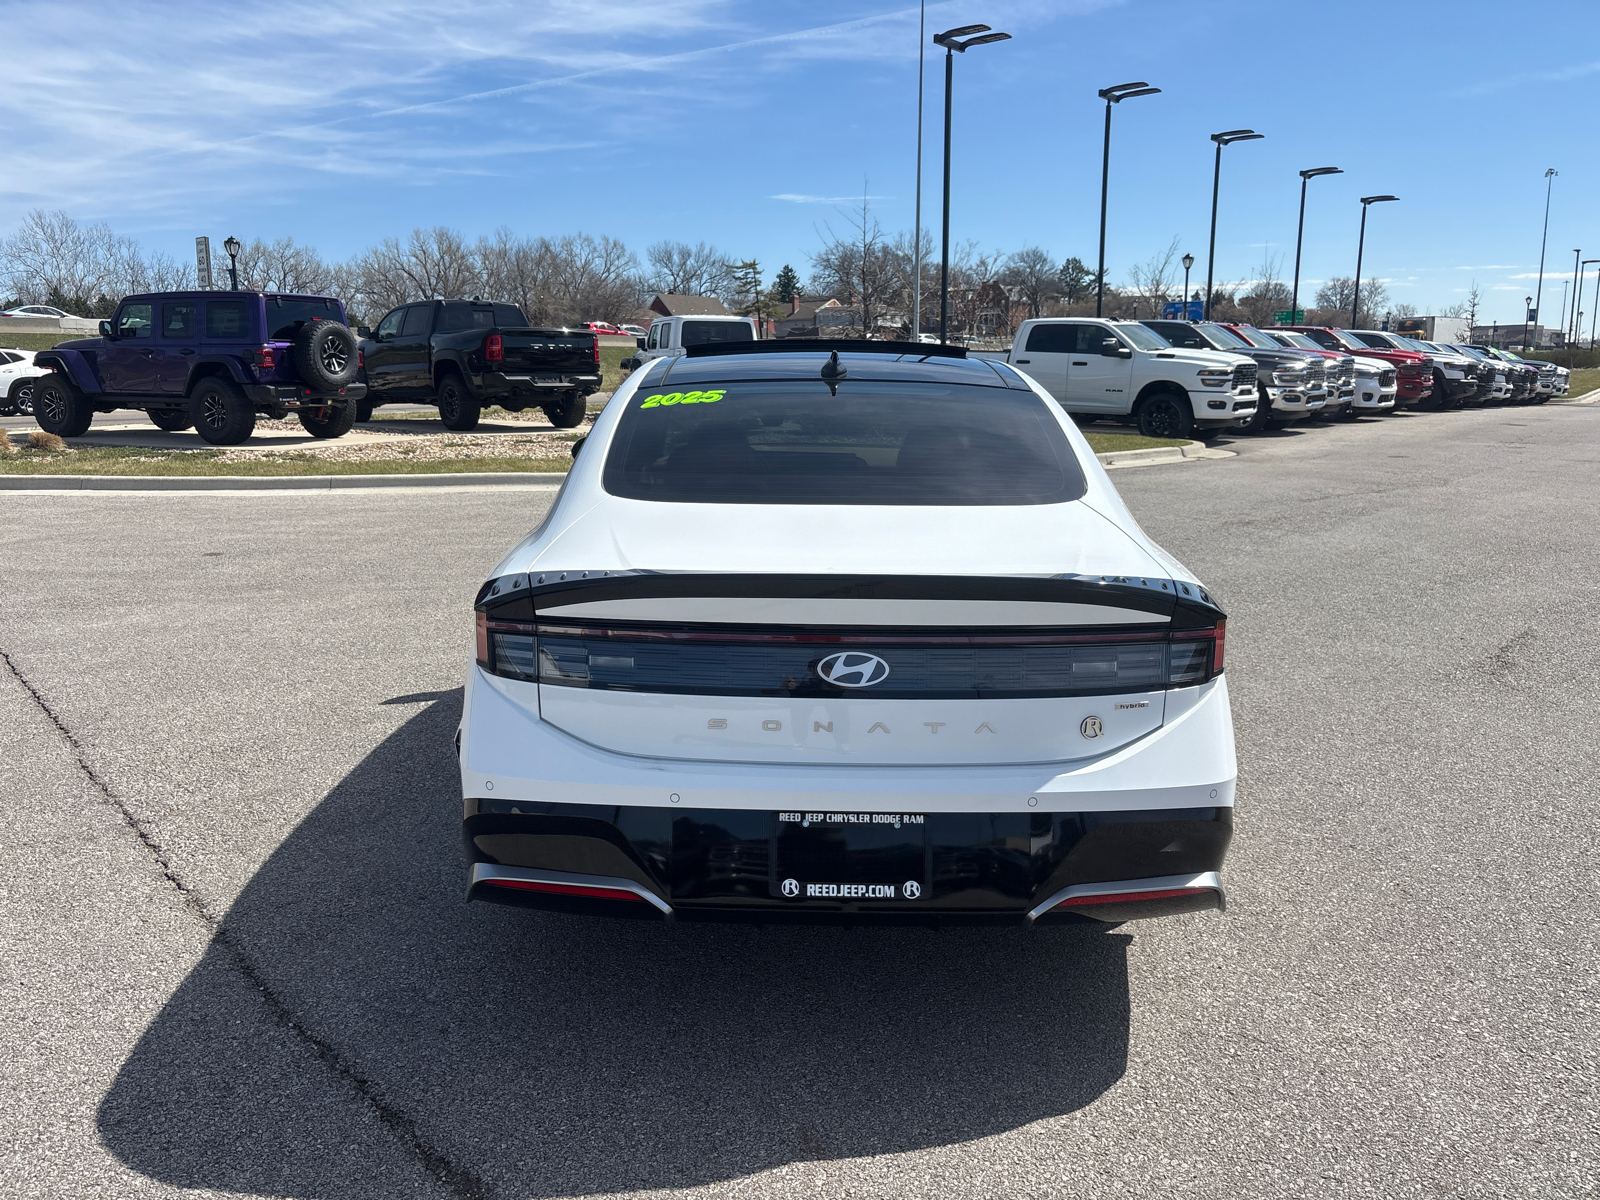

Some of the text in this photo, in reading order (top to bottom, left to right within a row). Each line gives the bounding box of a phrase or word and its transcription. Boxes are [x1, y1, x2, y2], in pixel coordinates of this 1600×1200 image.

[640, 390, 727, 409] 2025
[1120, 702, 1145, 710] hybrid
[707, 718, 997, 734] SONATA
[779, 812, 924, 824] REED JEEP CHRYSLER DODGE RAM
[806, 884, 895, 897] REEDJEEP.COM
